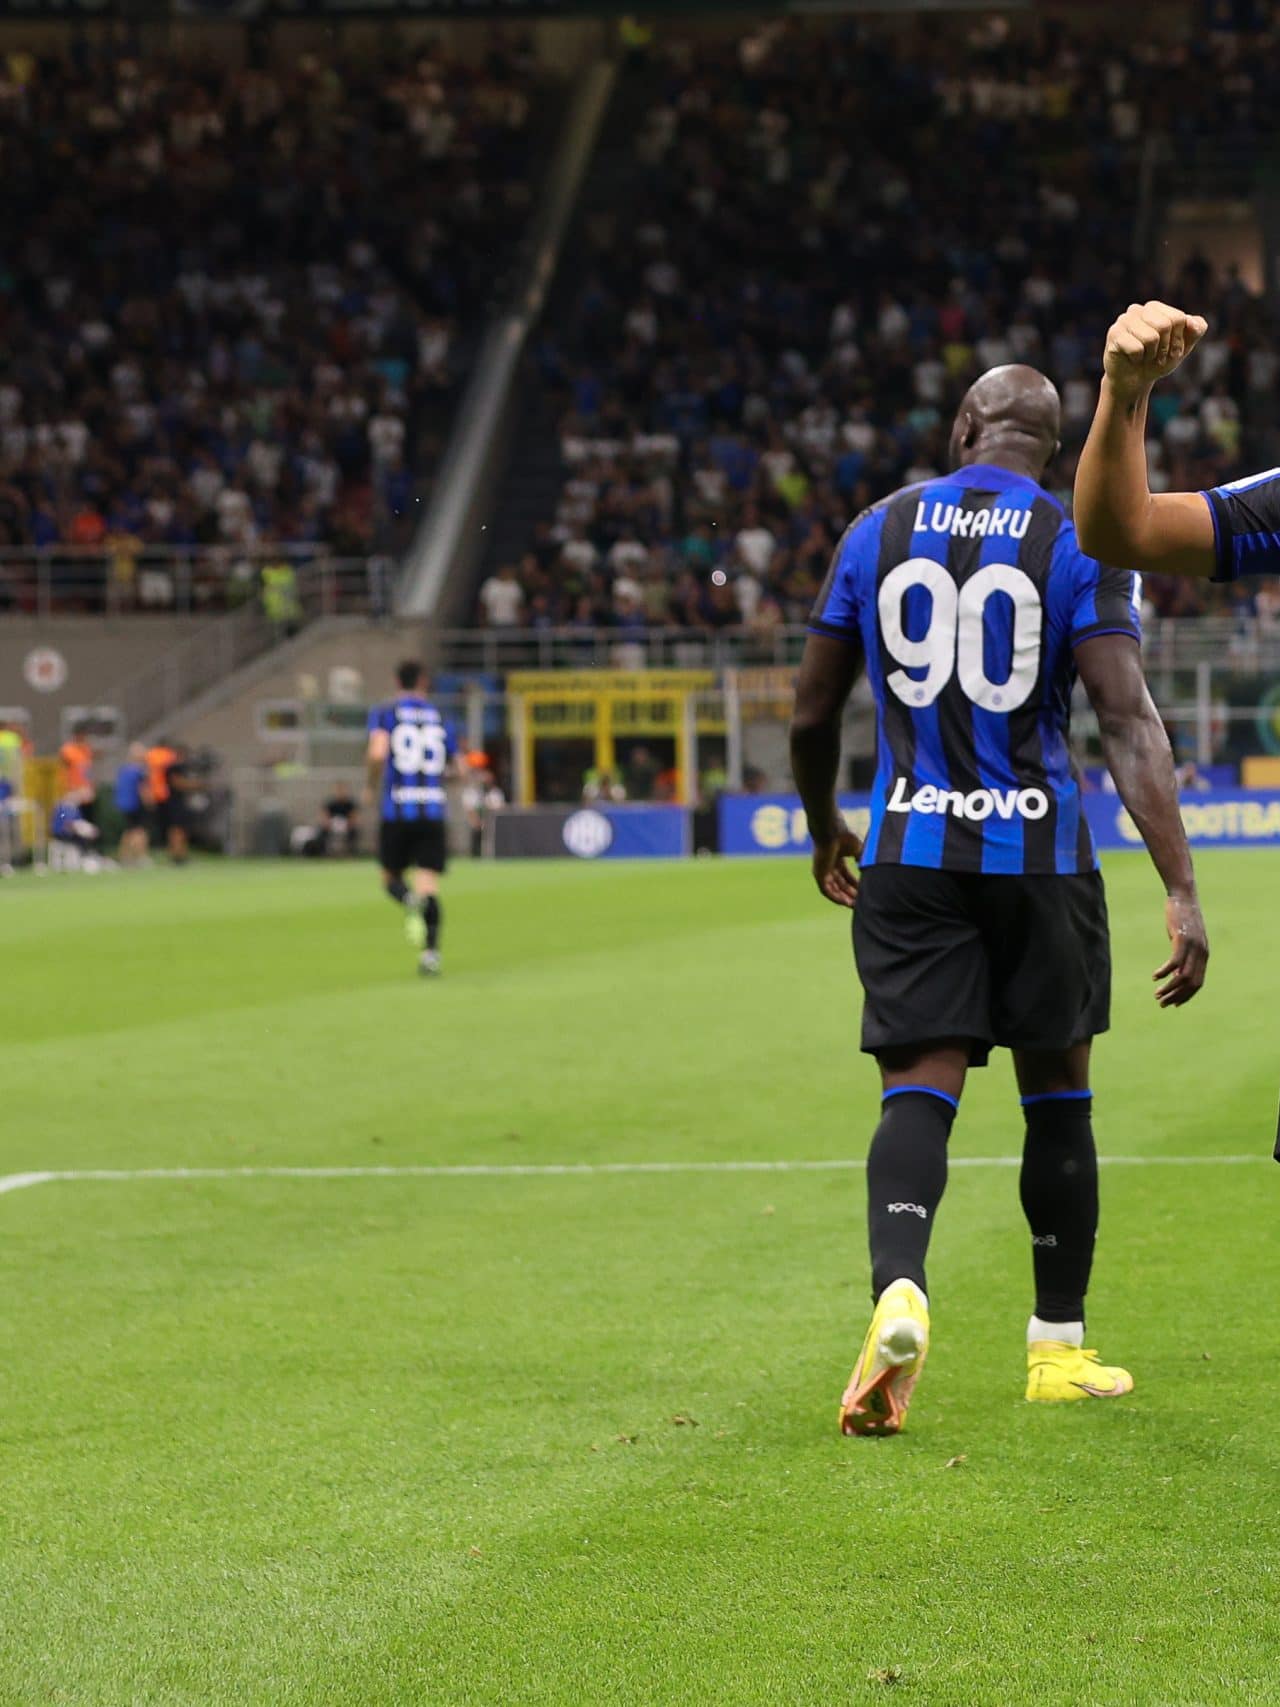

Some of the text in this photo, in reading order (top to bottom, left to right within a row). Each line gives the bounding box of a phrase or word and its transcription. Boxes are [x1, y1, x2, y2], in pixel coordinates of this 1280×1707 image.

[913, 500, 1033, 539] LUKAKU
[878, 557, 1042, 713] 90
[886, 776, 1049, 821] Lenovo
